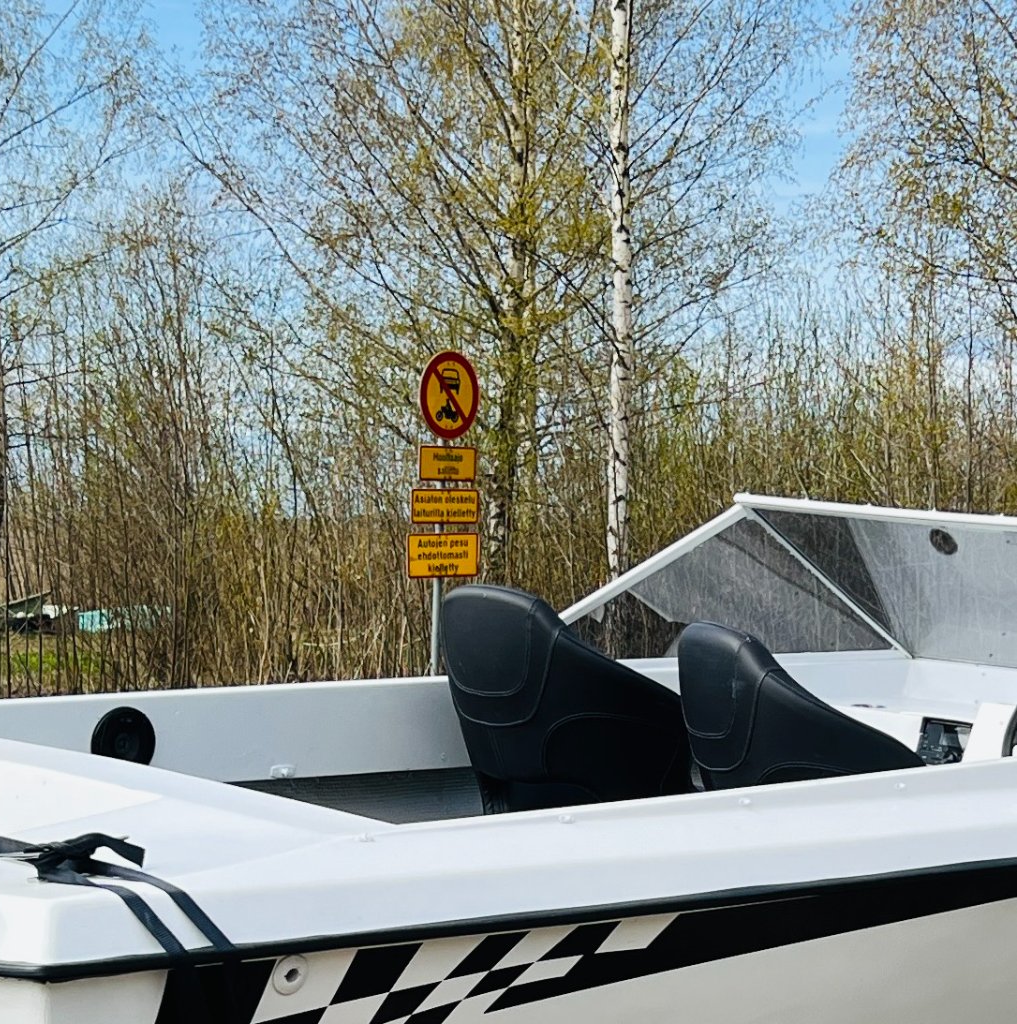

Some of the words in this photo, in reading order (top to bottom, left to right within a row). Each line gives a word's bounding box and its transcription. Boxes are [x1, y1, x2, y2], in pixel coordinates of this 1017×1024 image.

[414, 494, 443, 504] Asiaton
[445, 494, 475, 504] oleskelu
[413, 508, 444, 518] laiturilla
[446, 508, 477, 519] kielletty
[417, 538, 448, 549] Autojen
[449, 539, 469, 549] pesu
[417, 550, 469, 561] ehdottomasti
[428, 563, 458, 574] kielletty
